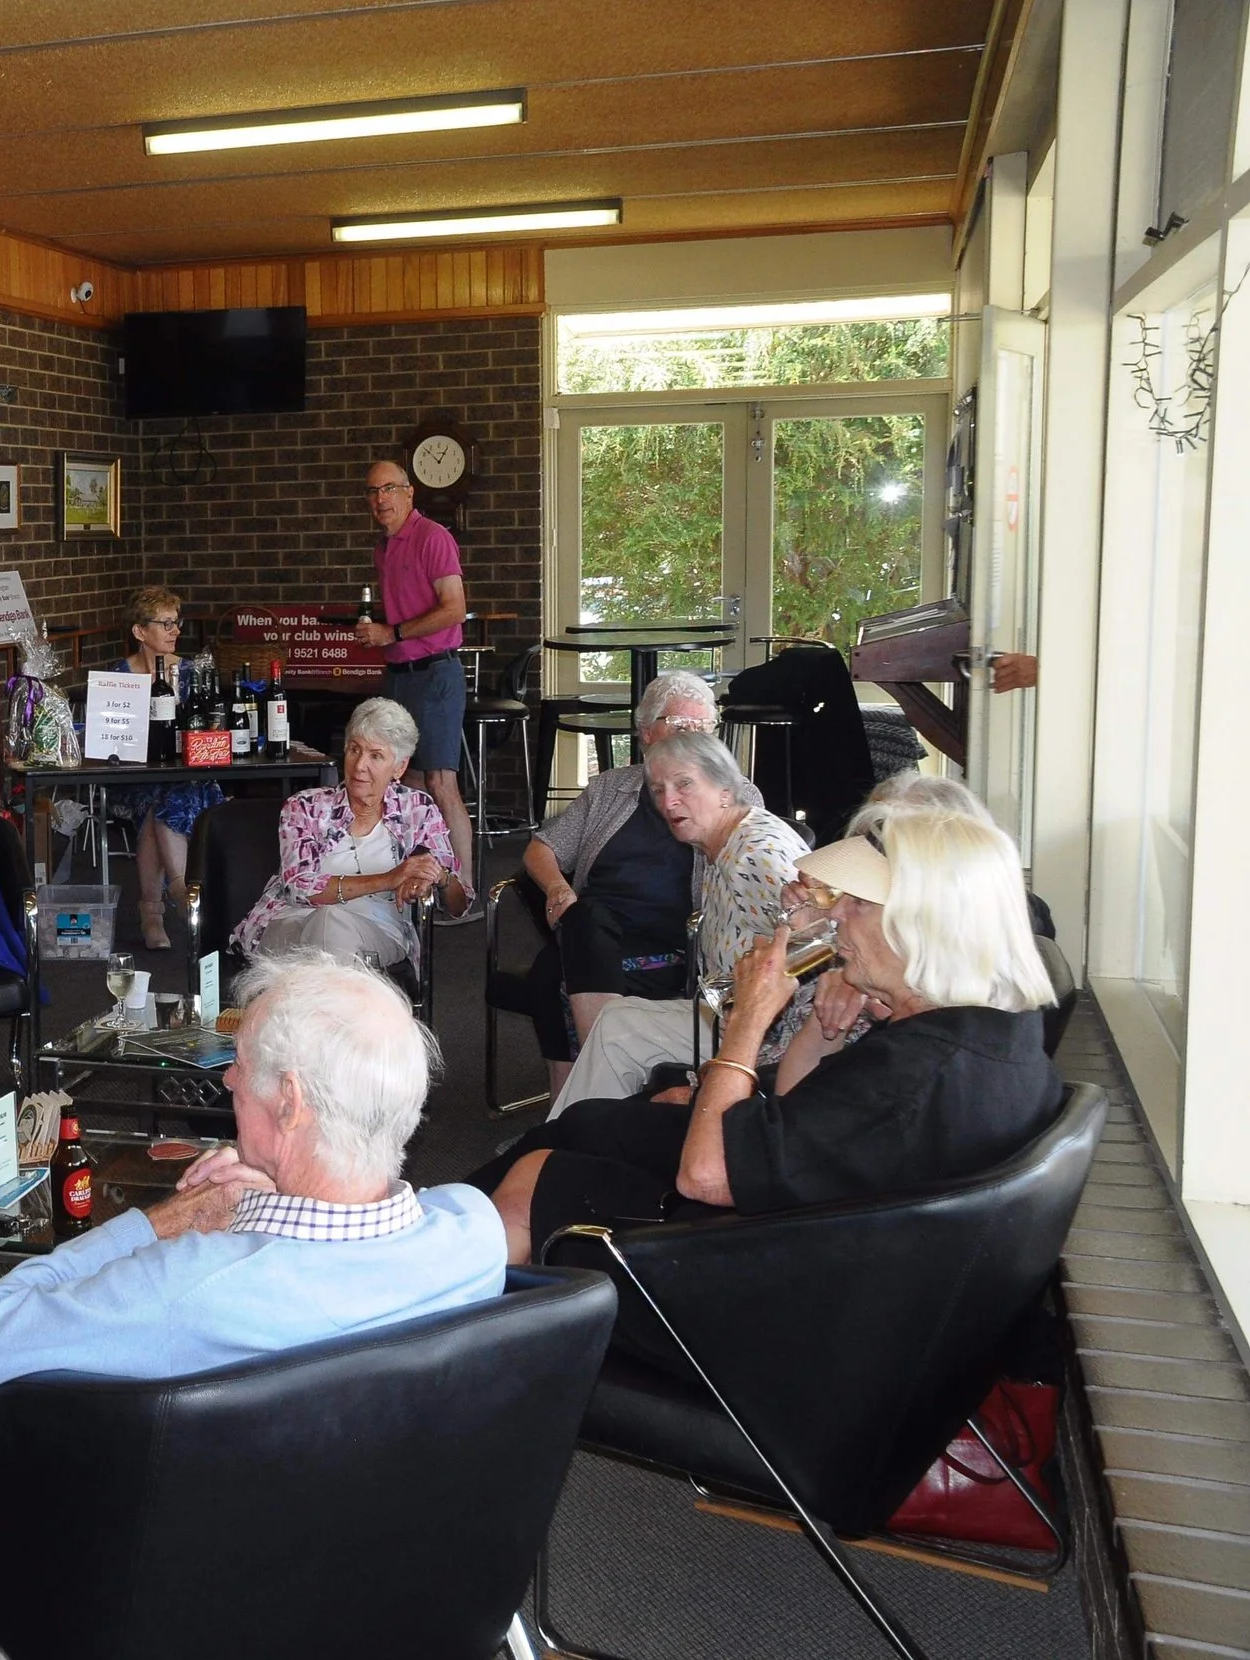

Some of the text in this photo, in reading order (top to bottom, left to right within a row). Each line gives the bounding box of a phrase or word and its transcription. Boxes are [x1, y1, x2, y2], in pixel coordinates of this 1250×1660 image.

[16, 609, 30, 620] Bank
[237, 615, 272, 626] When
[294, 630, 321, 641] club
[325, 630, 358, 641] wins.
[294, 648, 318, 658] 9521
[322, 648, 348, 658] 6488
[118, 681, 141, 689] Tickets
